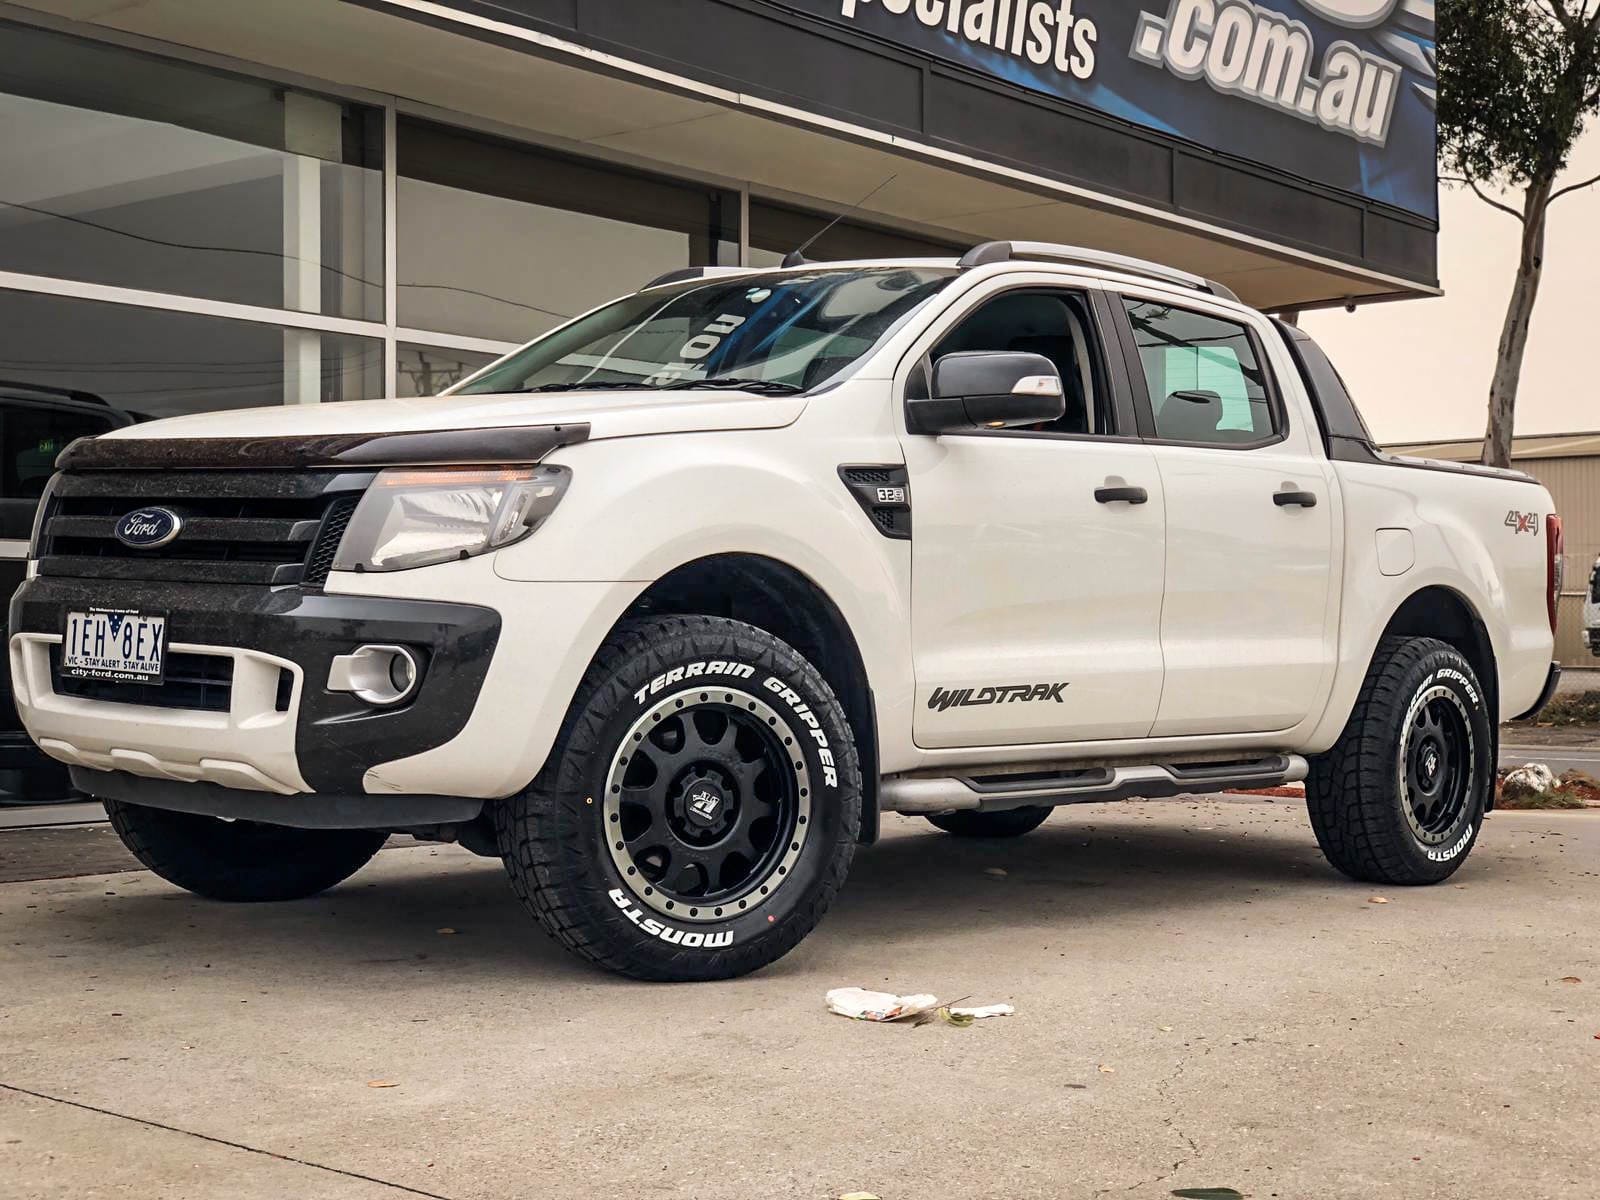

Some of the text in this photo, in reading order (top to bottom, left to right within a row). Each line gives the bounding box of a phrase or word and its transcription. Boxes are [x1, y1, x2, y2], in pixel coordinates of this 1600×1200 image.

[841, 0, 1097, 79] alists
[1137, 0, 1397, 140] .com.au
[125, 512, 162, 536] Ford
[71, 618, 162, 662] 1EH 8EX
[68, 656, 78, 665] VIC
[85, 657, 99, 666] STAY
[101, 659, 120, 668] ALERT
[123, 661, 139, 670] STAY
[141, 663, 159, 672] ALIVE
[71, 667, 149, 680] city-ford.com.au
[927, 682, 1070, 712] WILDTRAK
[1436, 668, 1479, 704] GRIPPER
[634, 661, 838, 789] TERRAIN GRIPPER
[1427, 823, 1473, 863] MONSTA
[608, 888, 734, 947] MONSTA
